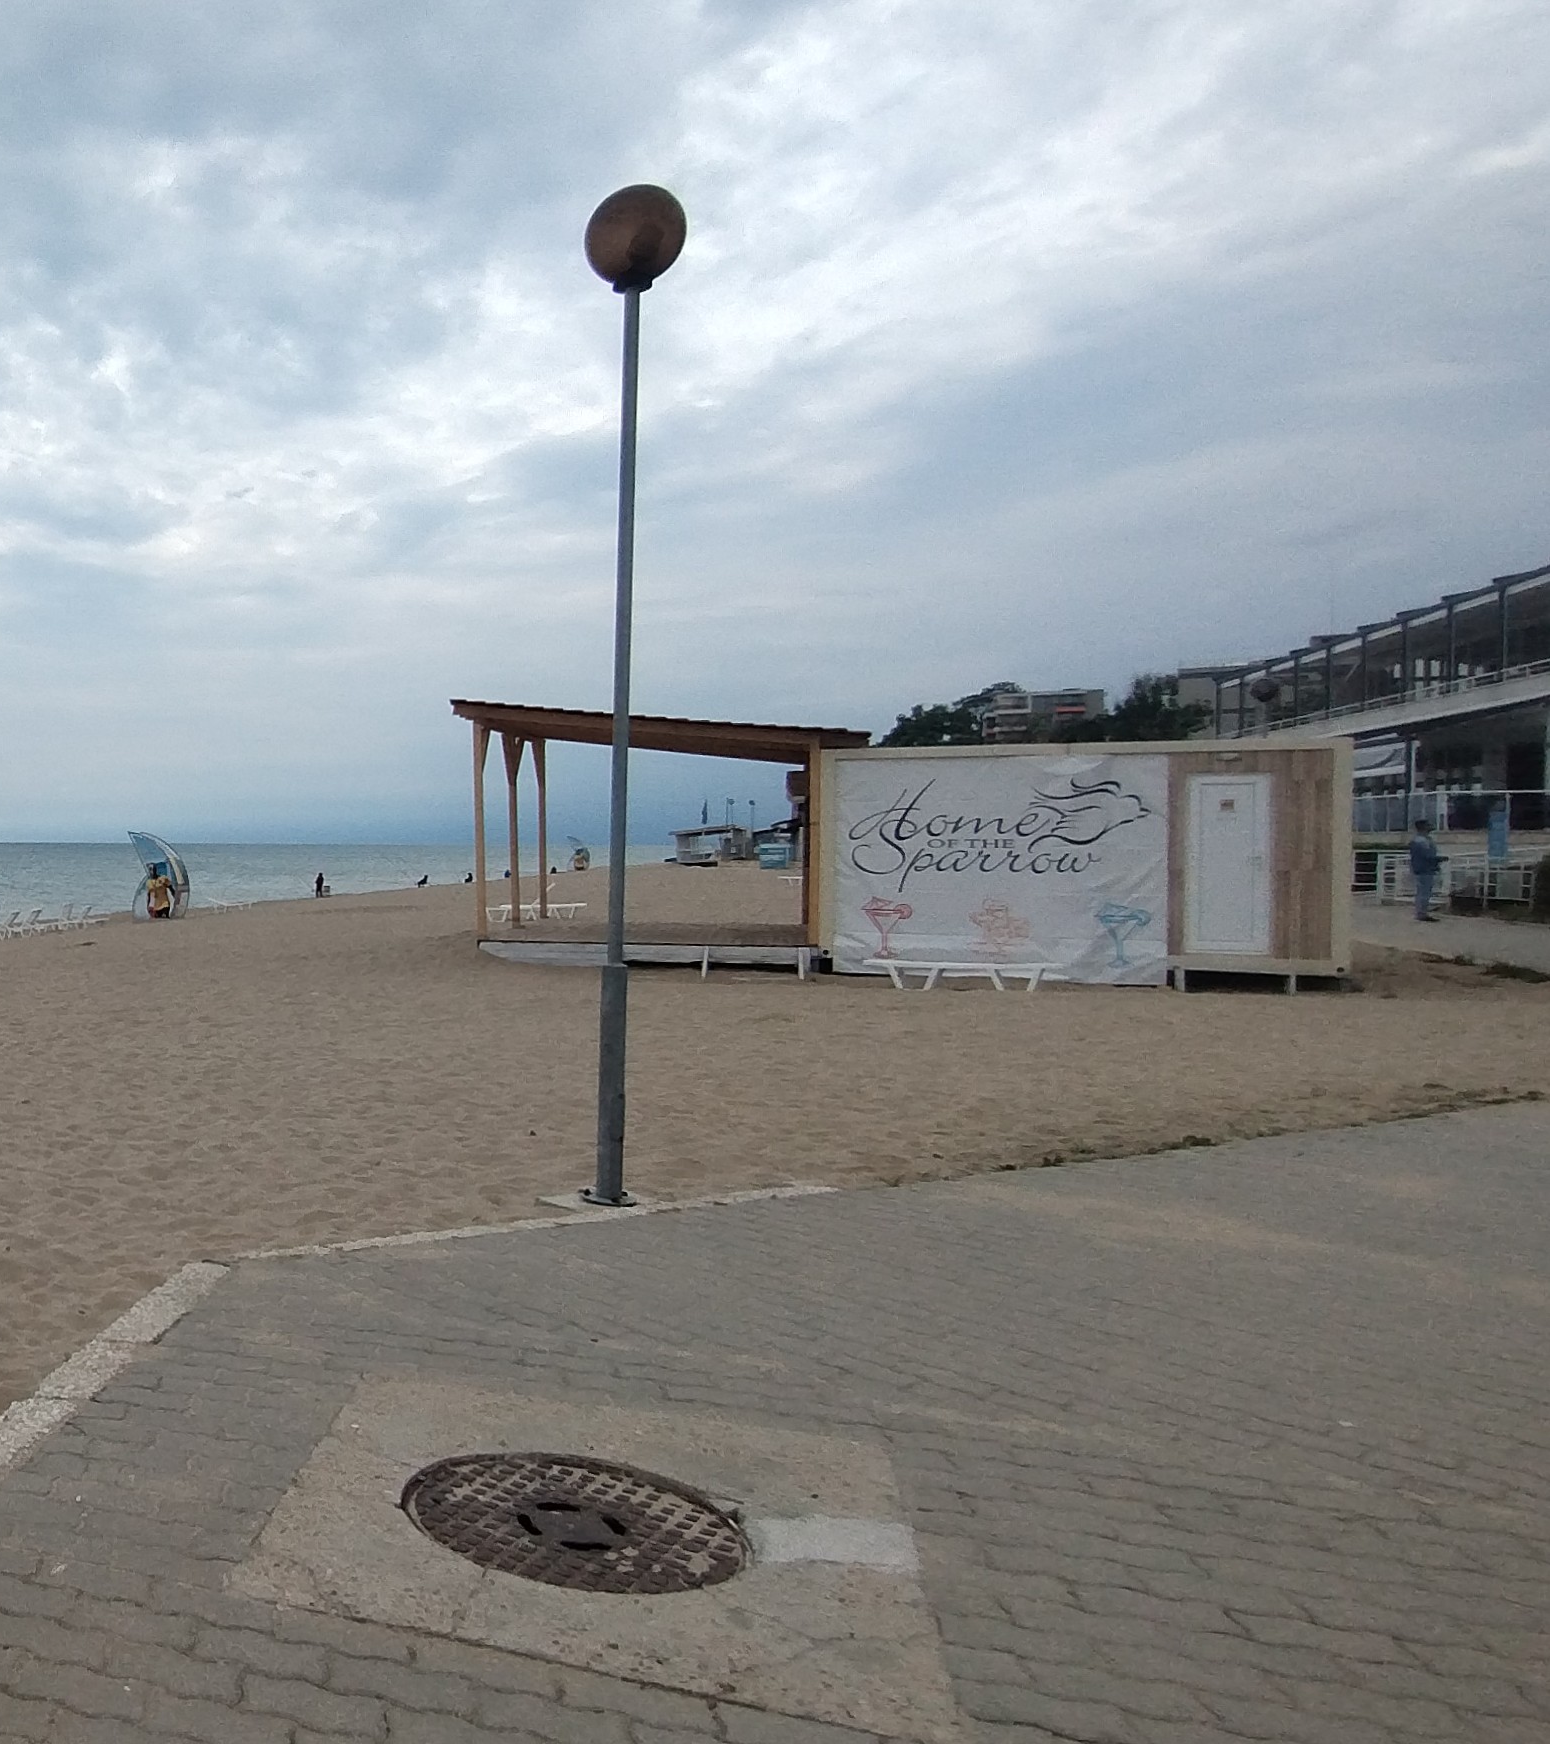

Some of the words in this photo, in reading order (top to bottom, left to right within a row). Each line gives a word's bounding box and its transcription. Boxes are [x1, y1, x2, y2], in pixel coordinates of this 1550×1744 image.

[848, 778, 1050, 841] Home
[851, 819, 1102, 893] Sparrow
[927, 838, 958, 848] OF
[964, 838, 1015, 848] THE
